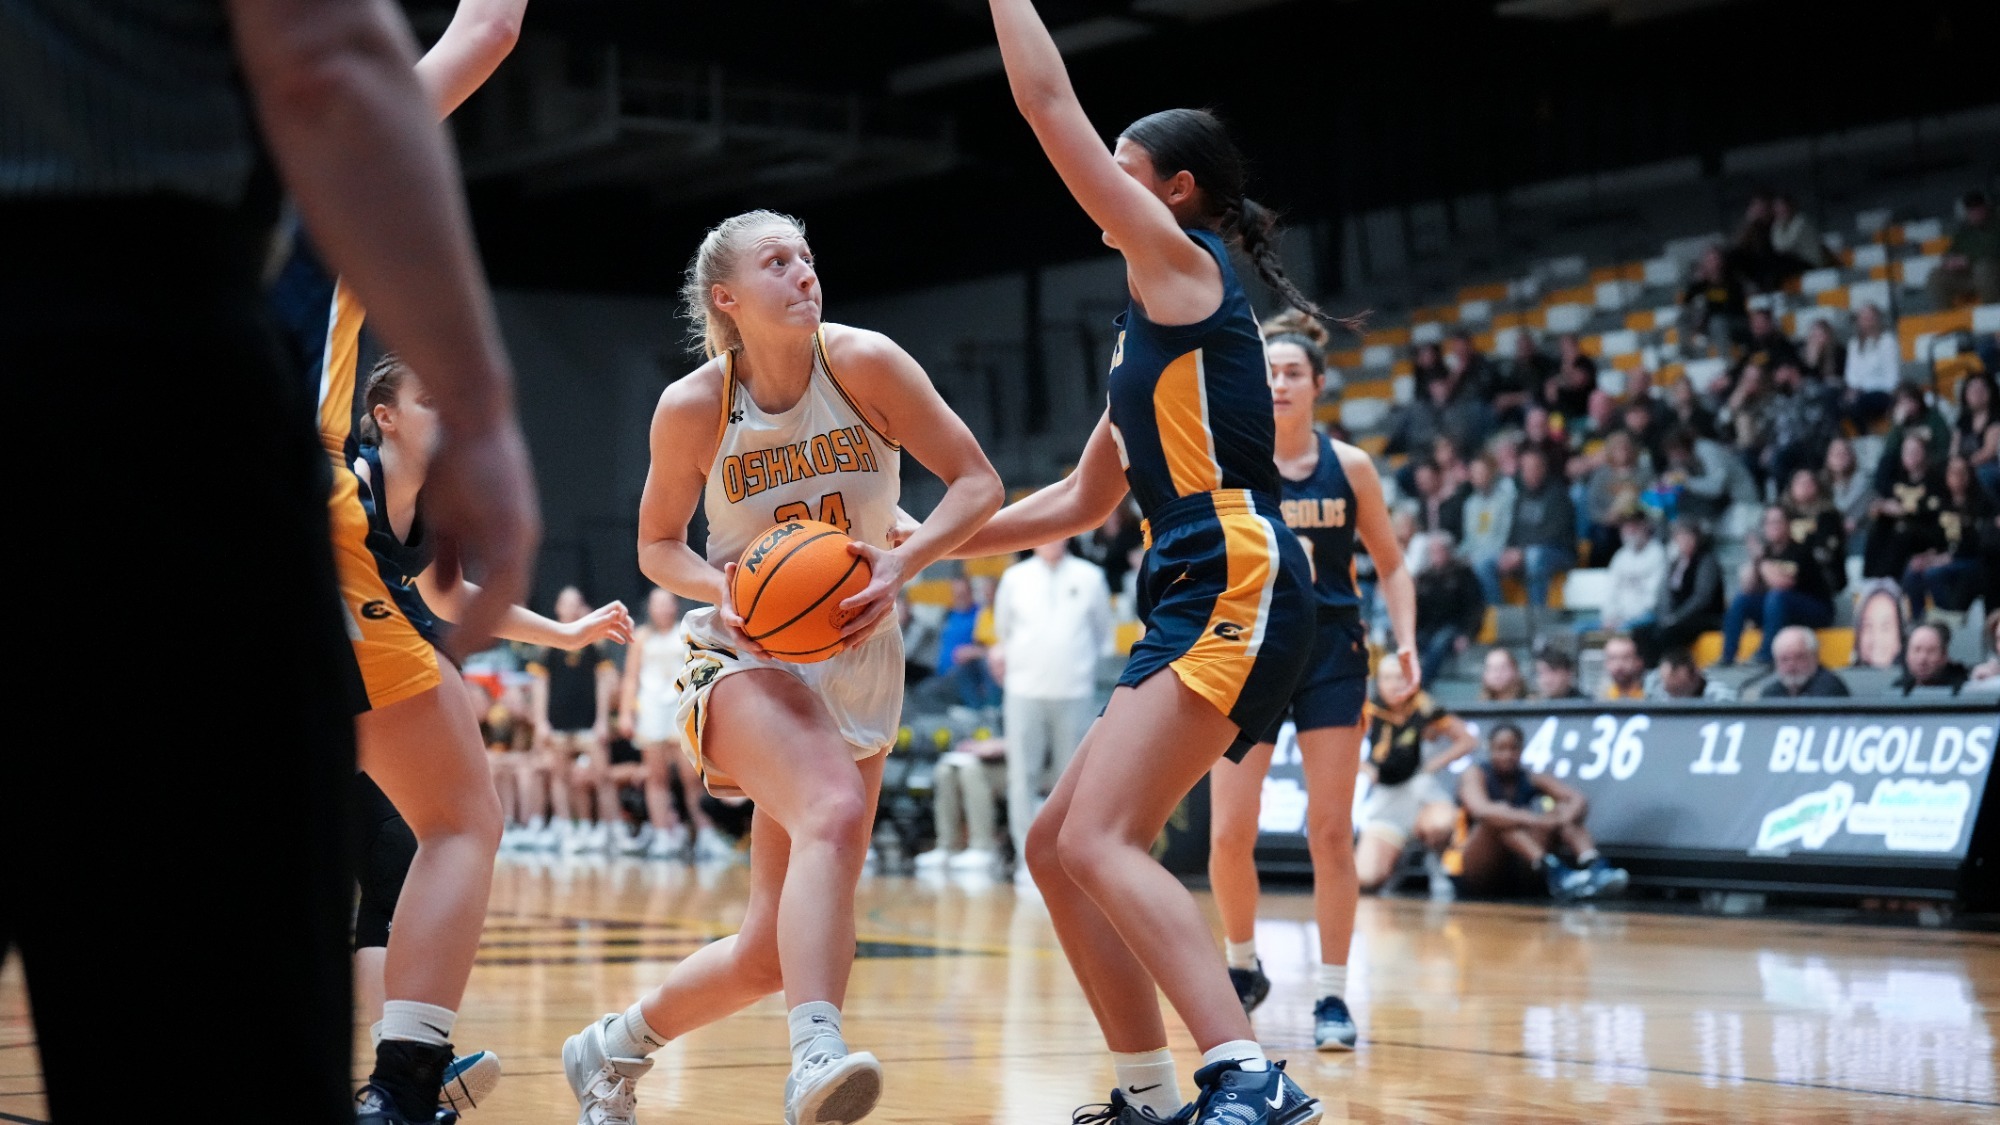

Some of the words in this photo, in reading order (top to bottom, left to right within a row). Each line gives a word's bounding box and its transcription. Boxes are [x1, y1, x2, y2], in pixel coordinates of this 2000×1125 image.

[723, 425, 878, 503] OSHKOSH
[1279, 498, 1346, 528] GOLDS
[746, 523, 805, 574] NCAA
[1520, 714, 1650, 780] 4:36
[1689, 721, 1745, 774] 11
[1768, 725, 1993, 775] BLUGOLDS
